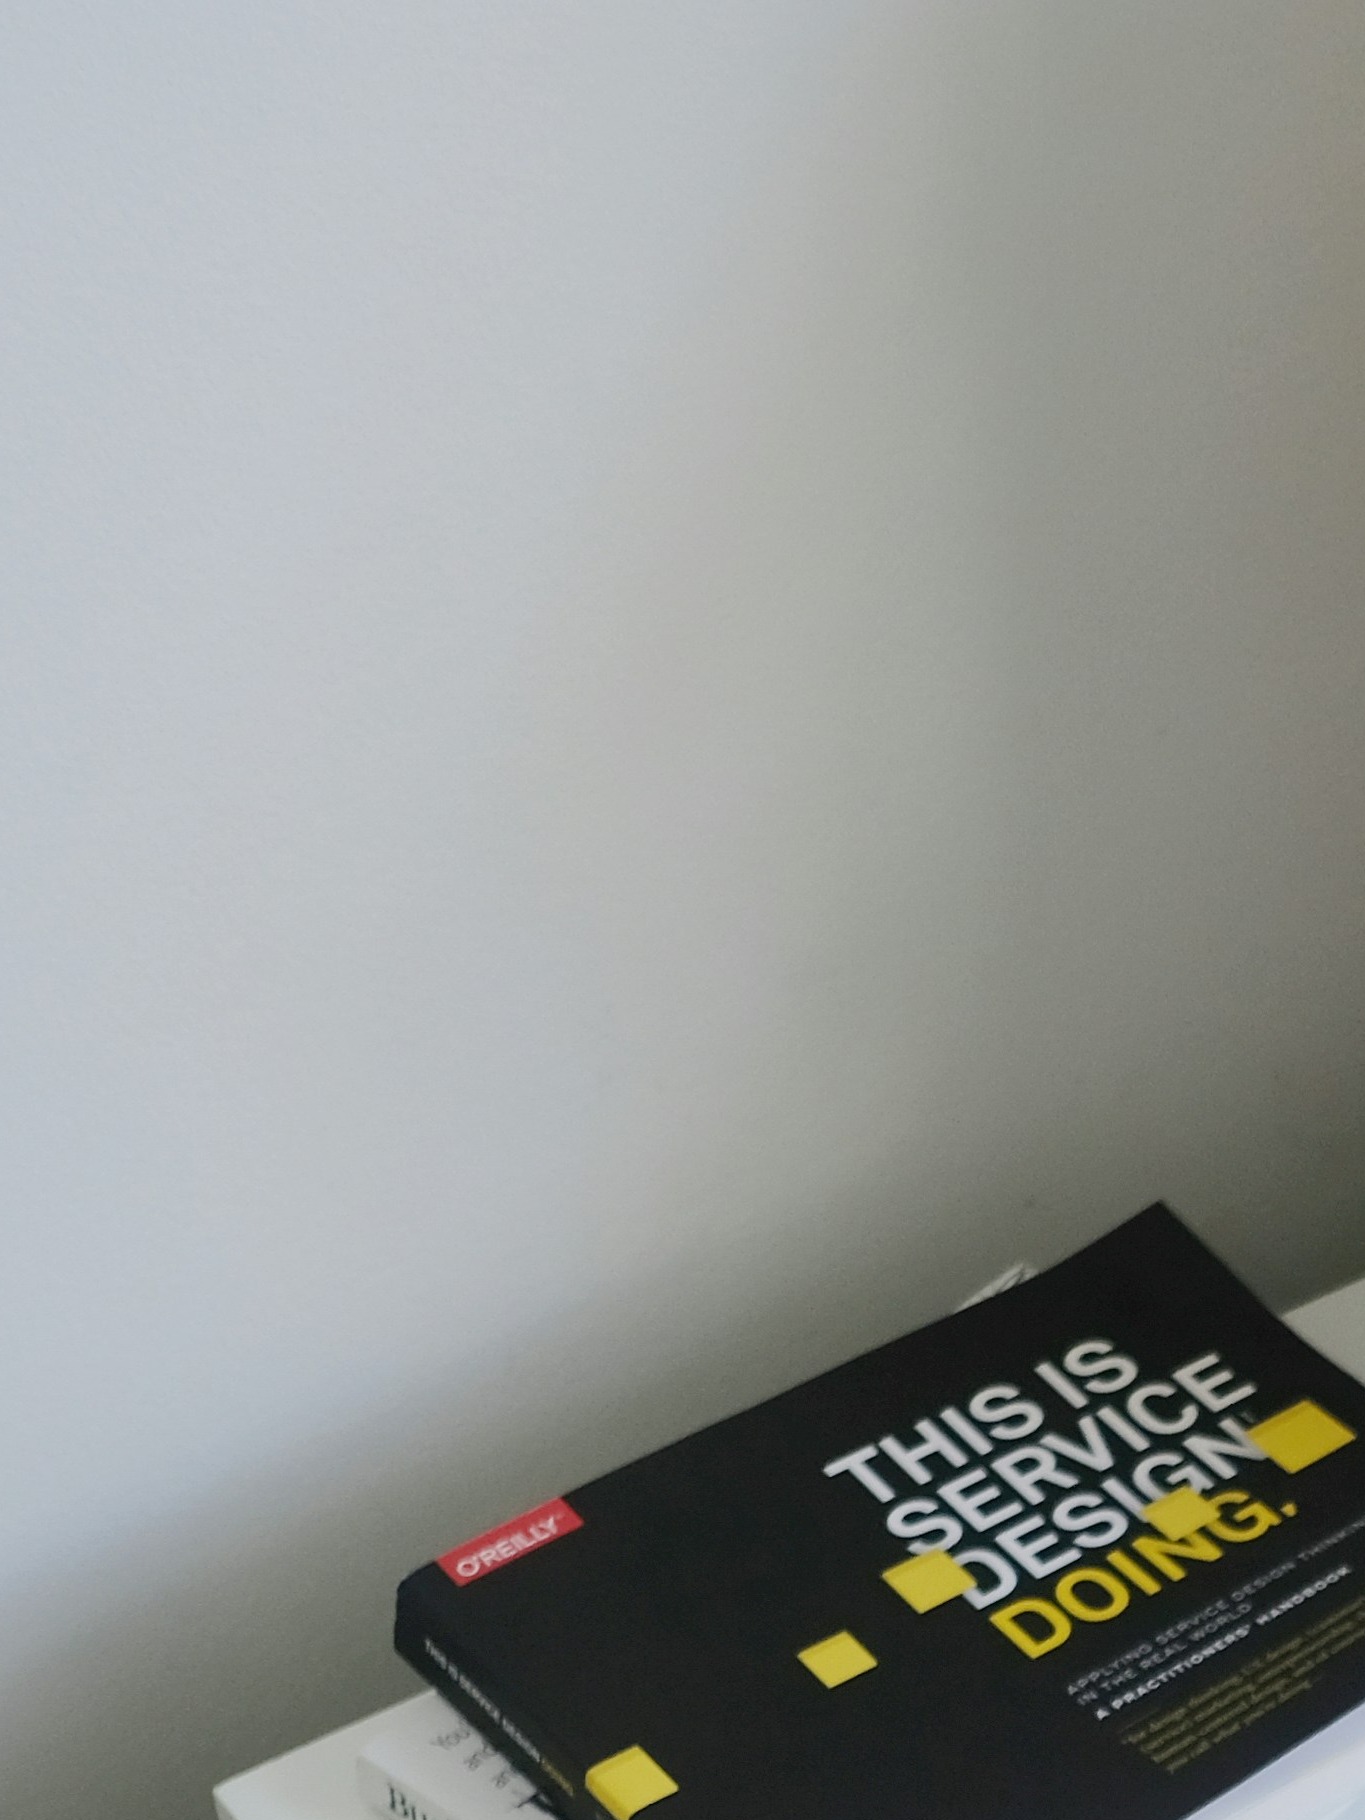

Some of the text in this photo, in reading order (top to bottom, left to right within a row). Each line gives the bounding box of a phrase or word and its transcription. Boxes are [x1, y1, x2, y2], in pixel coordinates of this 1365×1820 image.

[822, 1339, 1139, 1505] THIS IS
[886, 1351, 1259, 1556] SERVICE
[952, 1416, 1269, 1611] DESIGN
[1255, 1564, 1351, 1626] HANDBOOK
